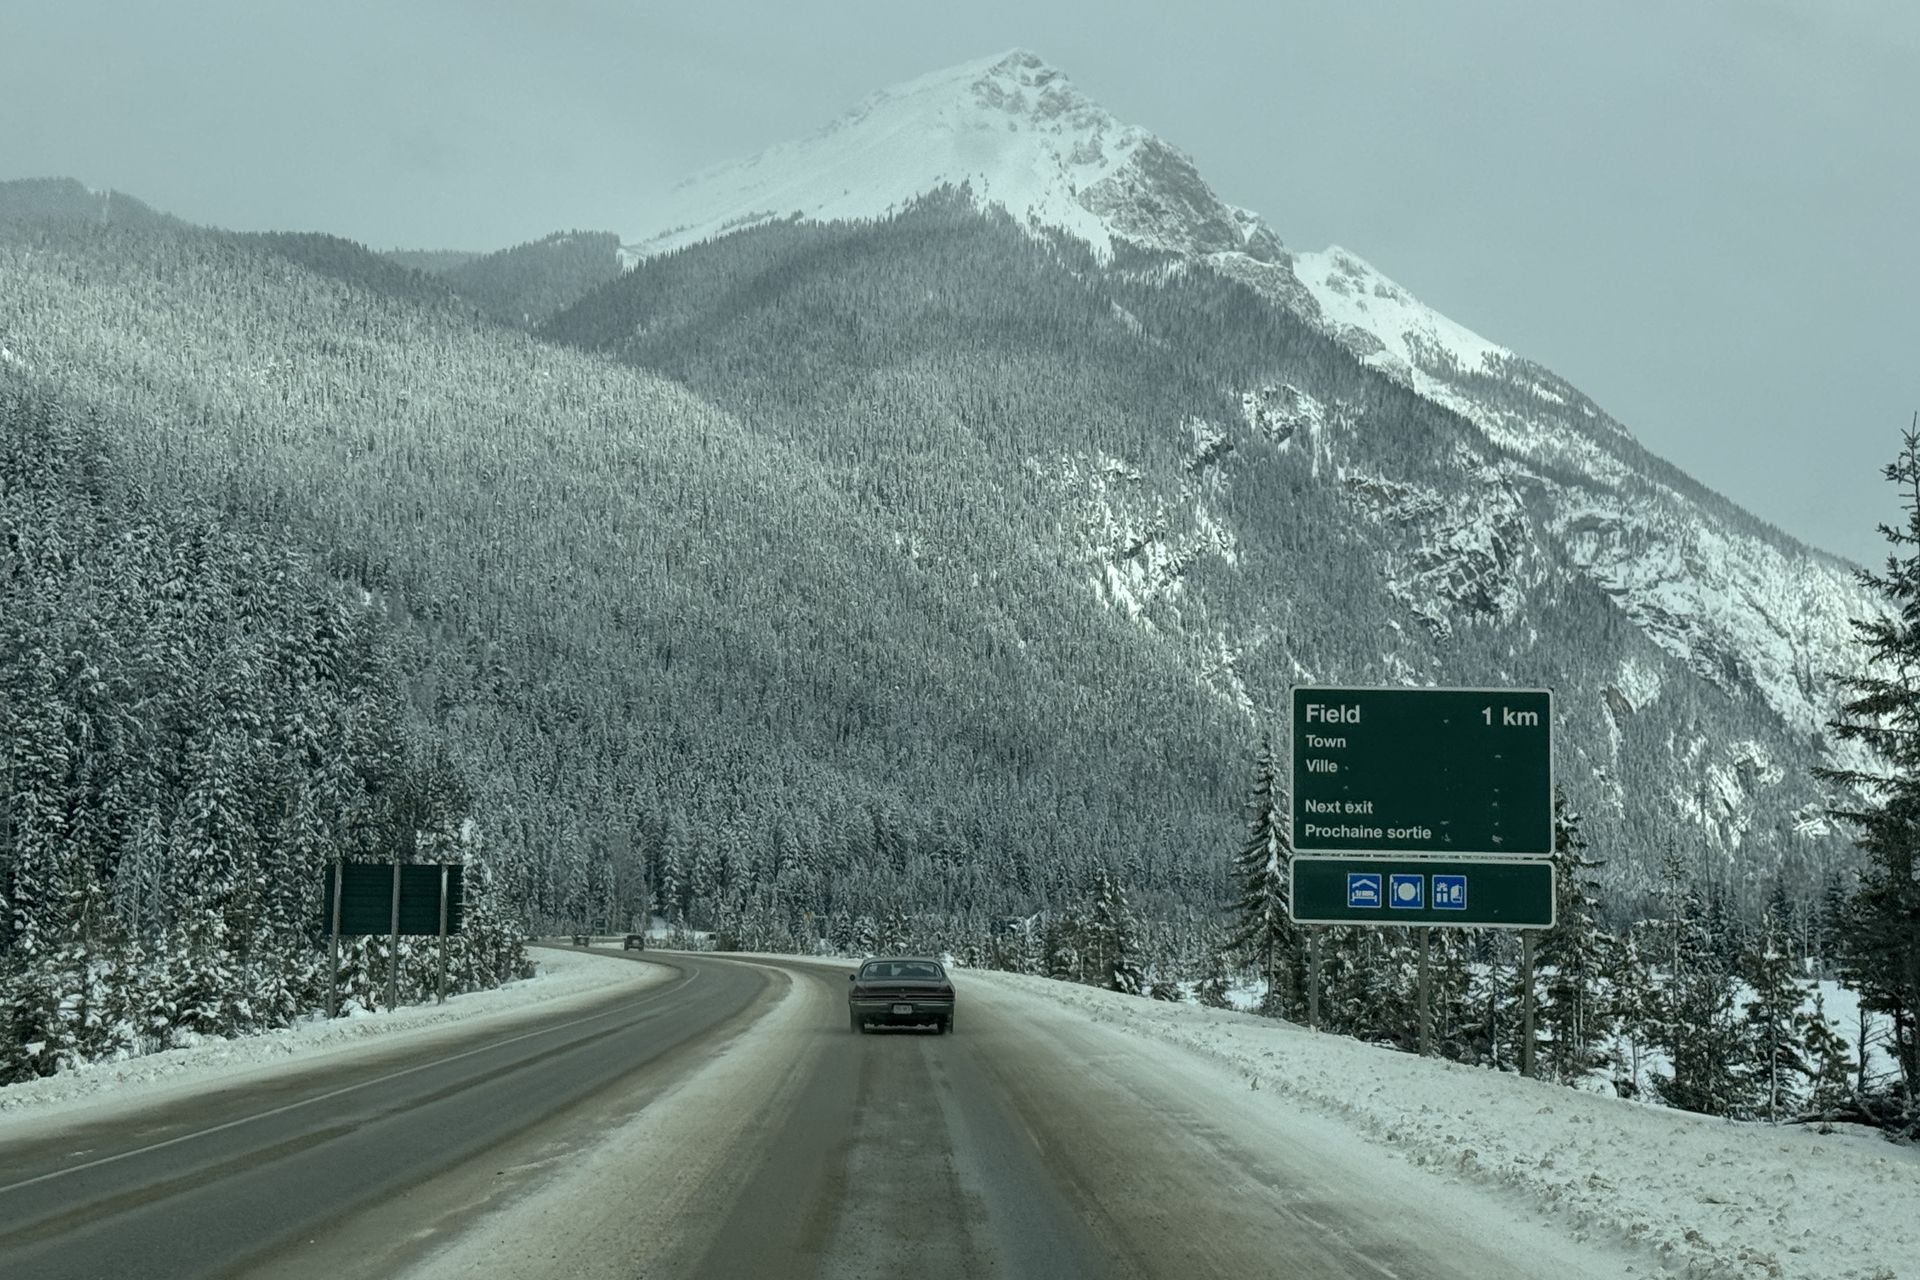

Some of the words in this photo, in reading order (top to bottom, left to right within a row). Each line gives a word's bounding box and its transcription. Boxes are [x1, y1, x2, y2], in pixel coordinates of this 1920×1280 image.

[1306, 703, 1361, 724] Field
[1481, 706, 1492, 726] 1
[1503, 706, 1539, 727] km
[1305, 734, 1347, 748] Town
[1305, 758, 1338, 773] Ville
[1305, 799, 1341, 814] Next
[1344, 800, 1374, 815] exit
[1305, 823, 1383, 839] Prochaine
[1386, 825, 1432, 840] sortie
